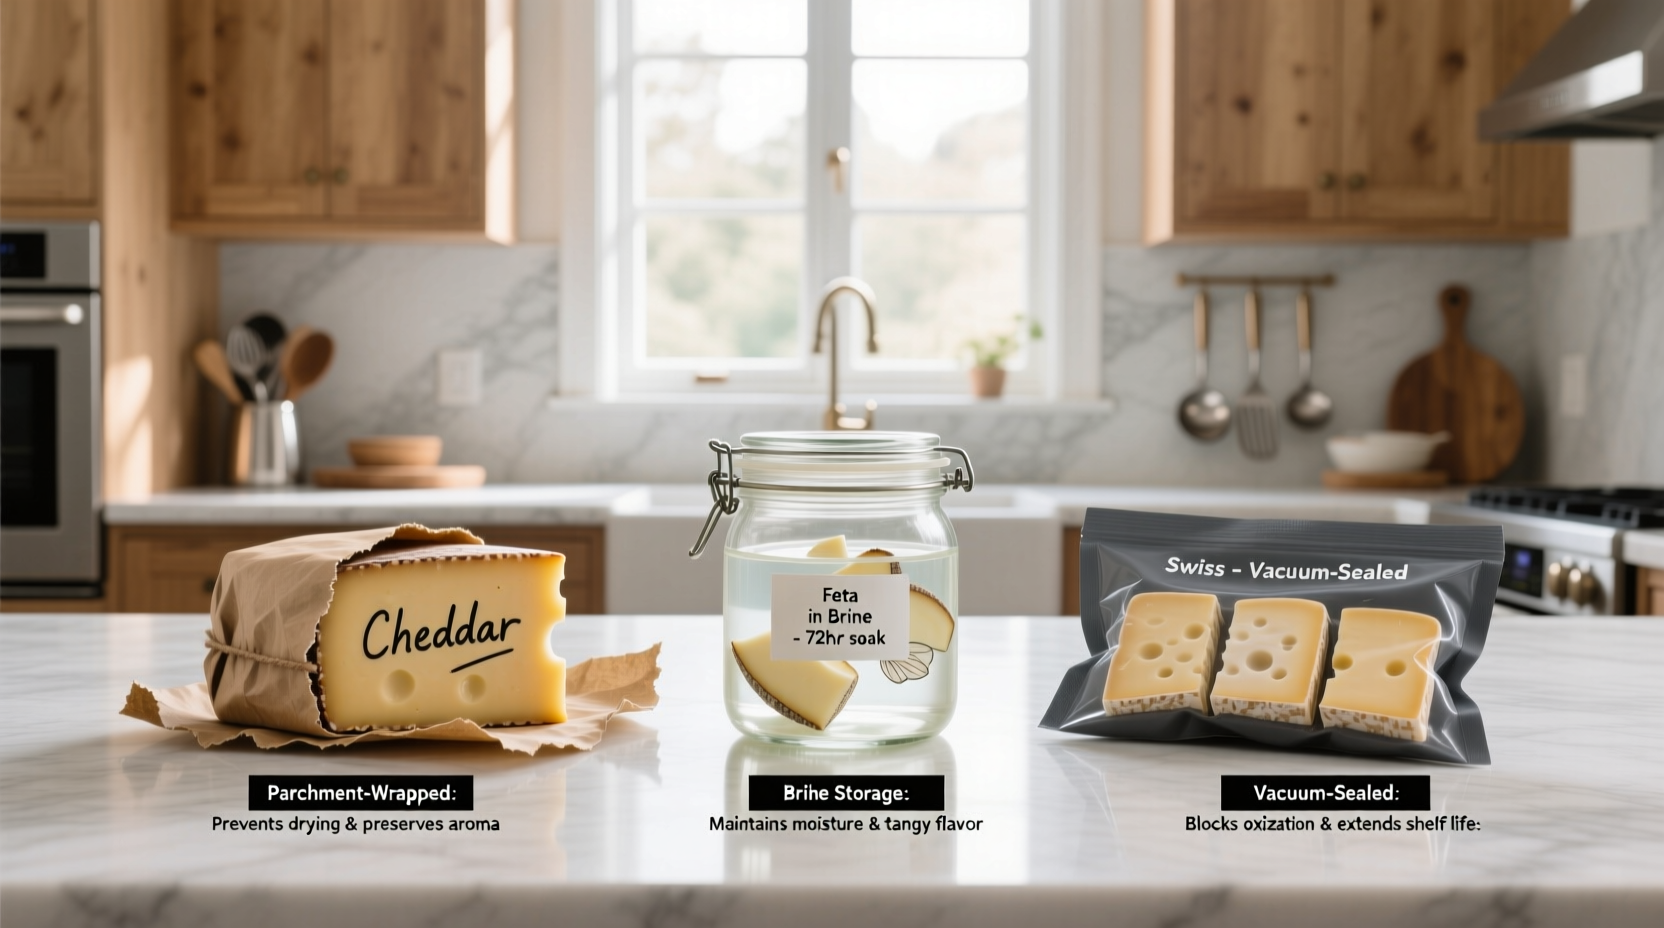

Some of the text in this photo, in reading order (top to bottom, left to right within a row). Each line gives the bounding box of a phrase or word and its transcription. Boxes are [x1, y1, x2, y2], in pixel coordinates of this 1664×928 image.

[1165, 556, 1225, 577] Swiss
[1250, 562, 1409, 581] Vacuum-Sealed
[823, 587, 859, 603] Feta
[808, 608, 872, 624] in Brine
[363, 600, 522, 660] Cheddar
[806, 630, 844, 645] 72hr
[849, 629, 886, 645] soak
